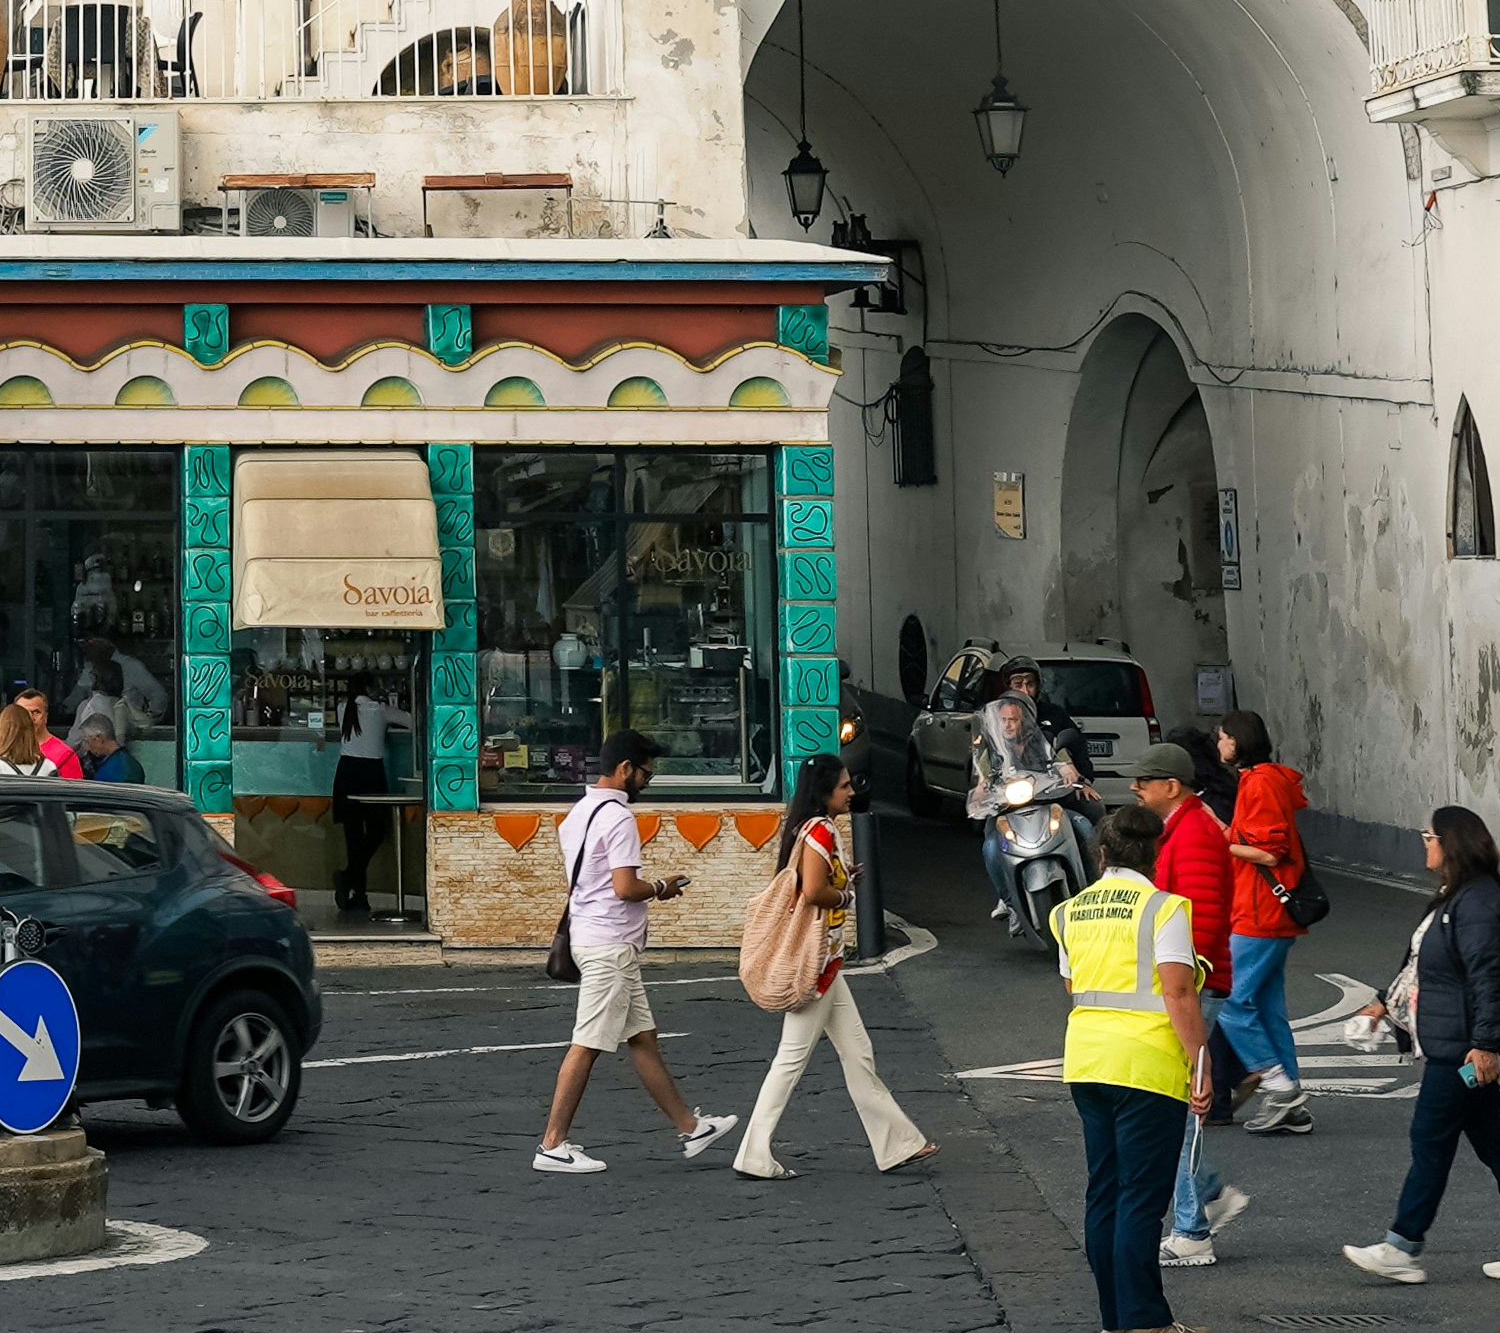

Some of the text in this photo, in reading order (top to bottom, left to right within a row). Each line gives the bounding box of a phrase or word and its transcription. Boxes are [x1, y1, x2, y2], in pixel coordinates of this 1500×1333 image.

[653, 541, 753, 574] Savoia
[343, 573, 434, 606] Savoia
[365, 608, 380, 617] bar
[244, 664, 312, 690] Savoia
[1101, 889, 1110, 905] DI
[1110, 889, 1141, 906] AMALFI
[1105, 907, 1134, 920] AMICA
